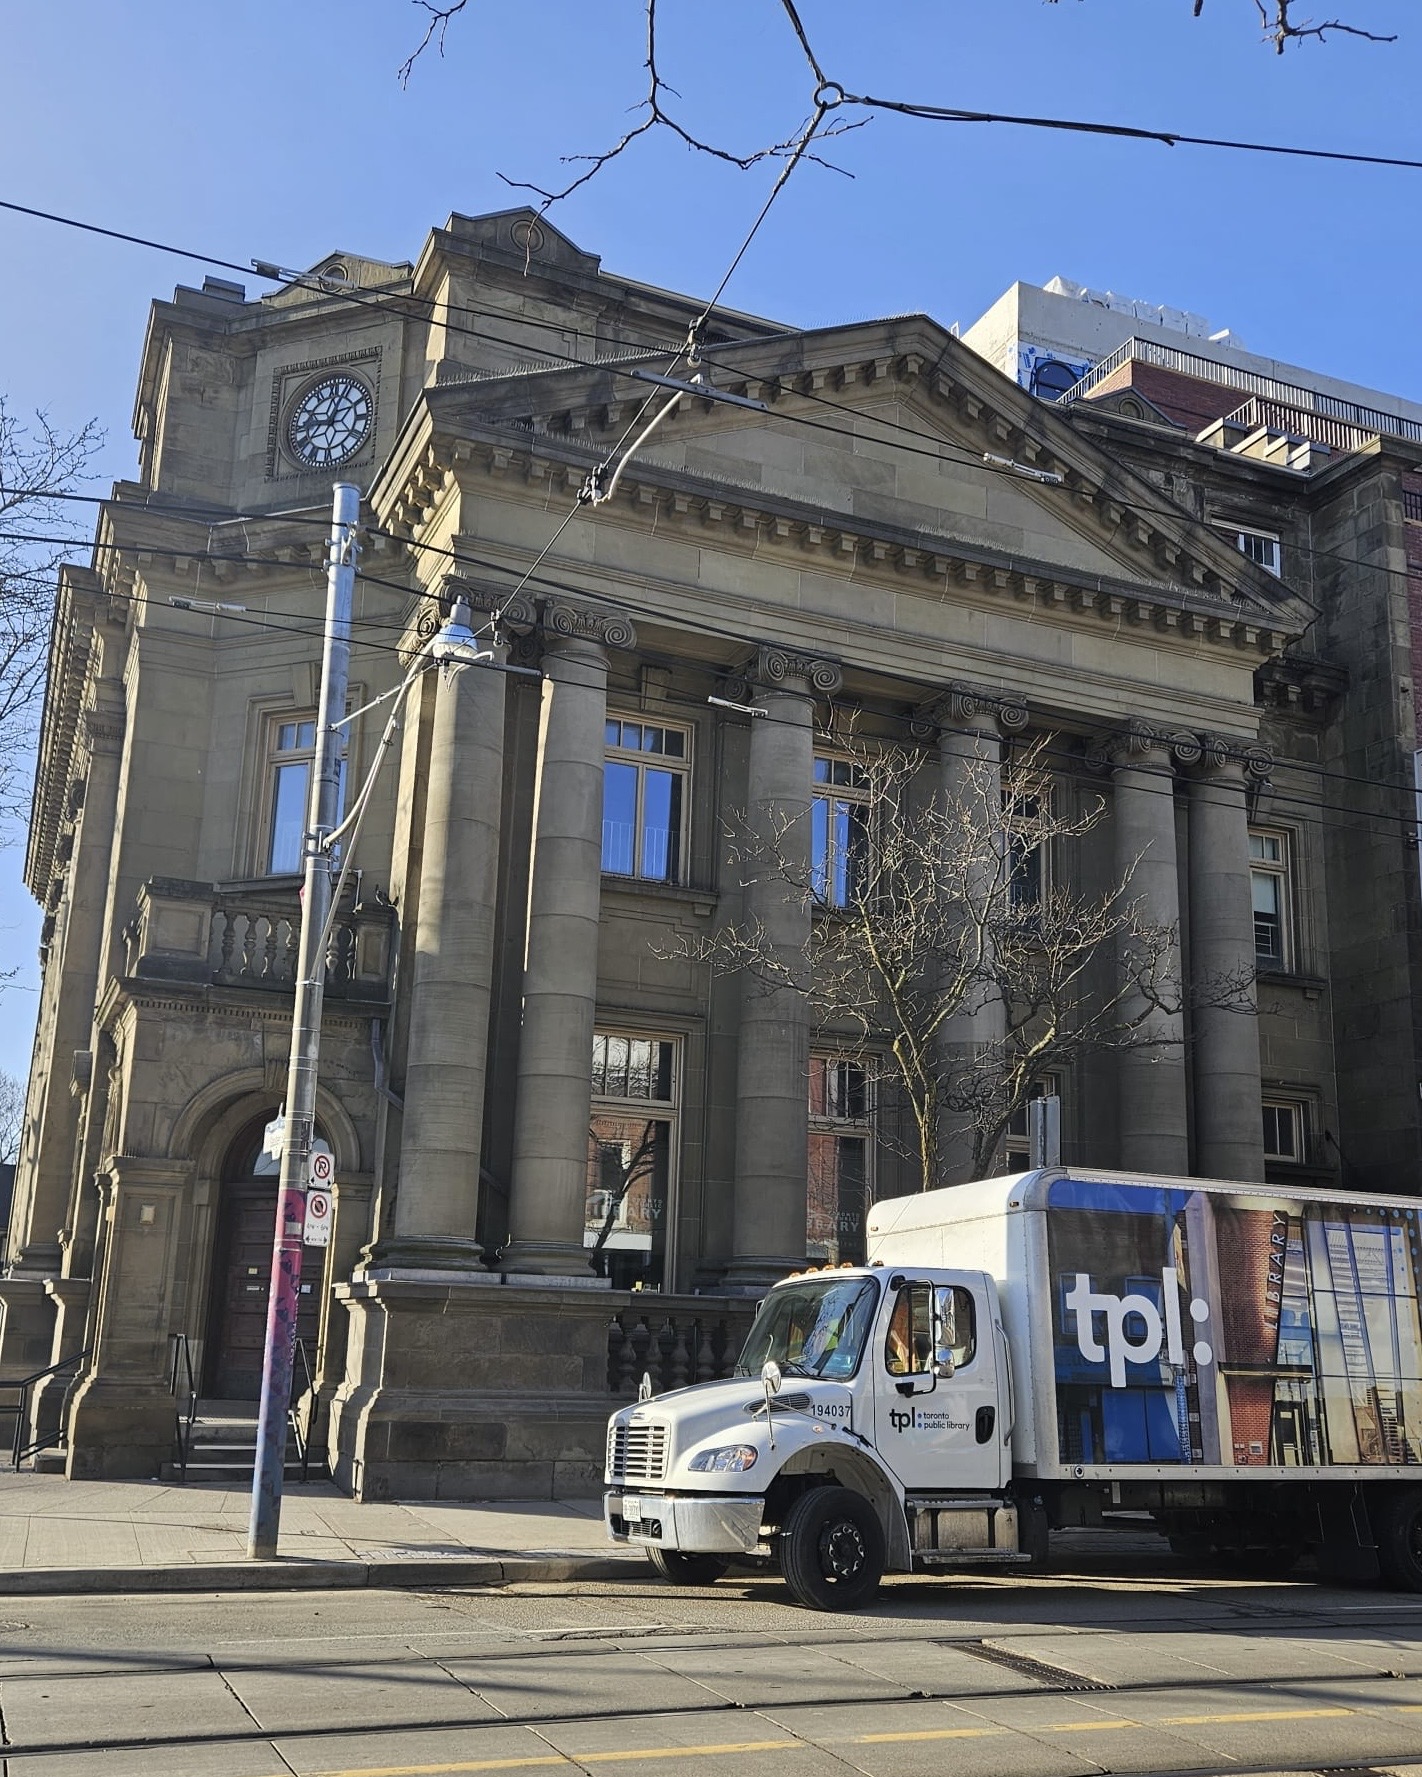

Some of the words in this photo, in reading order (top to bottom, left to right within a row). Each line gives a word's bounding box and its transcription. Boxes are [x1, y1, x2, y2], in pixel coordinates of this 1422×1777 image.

[1266, 1213, 1288, 1331] LIBRARY
[811, 1404, 851, 1417] 194037
[923, 1411, 950, 1420] toronto
[923, 1420, 946, 1430] public
[946, 1421, 970, 1431] library
